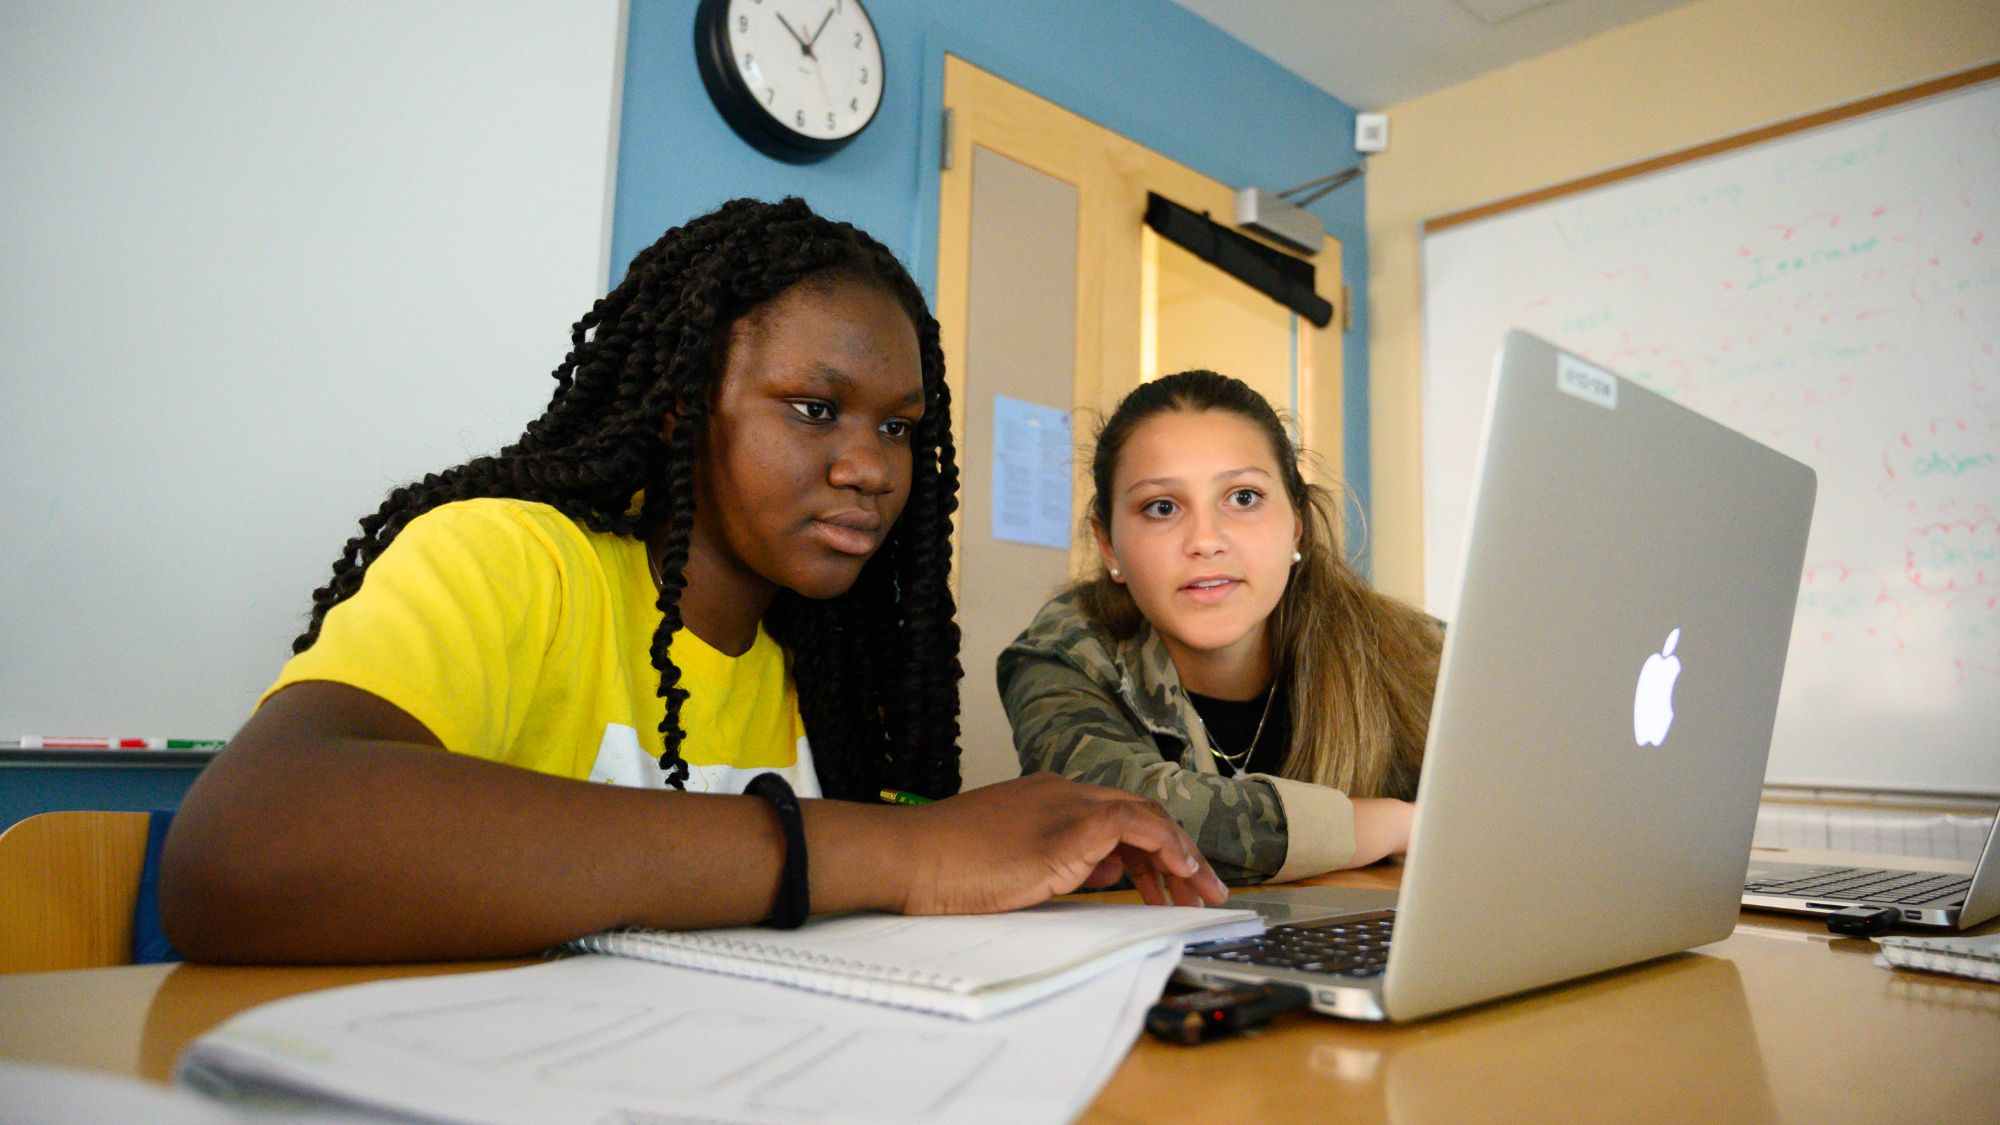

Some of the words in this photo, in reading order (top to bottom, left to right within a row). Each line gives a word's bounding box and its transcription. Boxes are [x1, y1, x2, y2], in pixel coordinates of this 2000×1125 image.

[739, 15, 748, 33] 9
[854, 32, 862, 49] 2
[859, 68, 869, 85] 3
[767, 88, 776, 106] 7
[849, 97, 858, 113] 4
[795, 110, 805, 128] 6
[827, 112, 836, 131] 5
